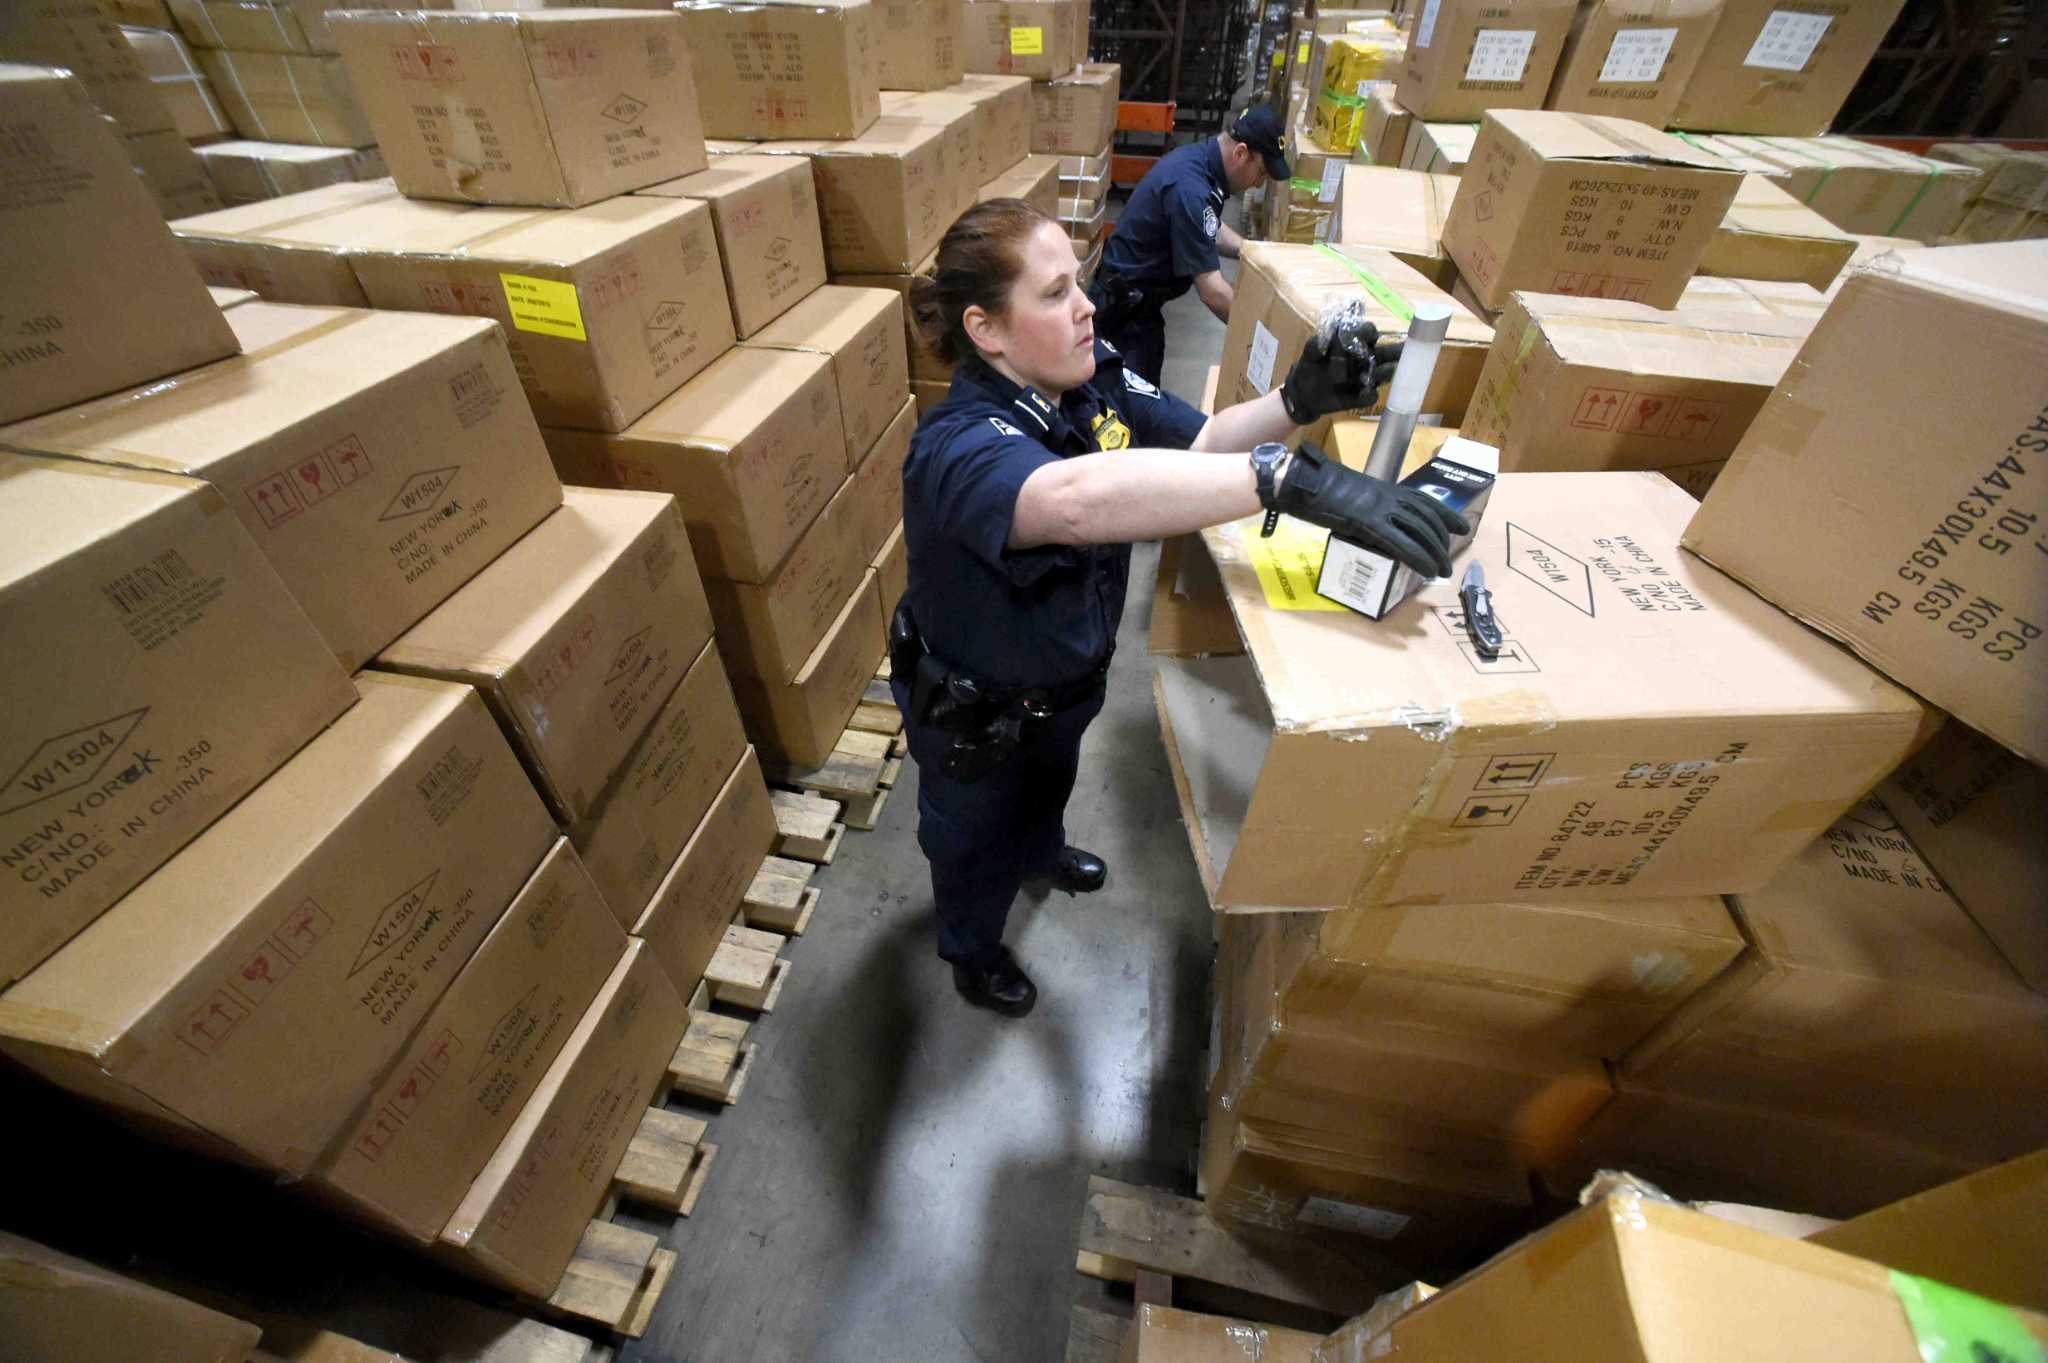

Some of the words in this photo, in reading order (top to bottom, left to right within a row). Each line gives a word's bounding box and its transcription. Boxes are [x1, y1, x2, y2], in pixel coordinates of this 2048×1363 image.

[1564, 212, 1592, 224] KGS
[1570, 197, 1599, 208] KGS
[1620, 200, 1634, 211] 10
[1561, 226, 1587, 238] PCS
[400, 476, 443, 510] W1504
[389, 529, 418, 557] NEW
[1978, 508, 2037, 556] 10.5
[405, 557, 438, 585] MADE
[455, 518, 488, 545] CHINA
[1526, 548, 1570, 583] W1504
[1614, 535, 1653, 566] CHINA
[1590, 555, 1628, 583] YORK
[1647, 565, 1669, 577] IN
[1619, 586, 1658, 612] NEW
[1661, 579, 1708, 611] MADE
[1861, 590, 1901, 625] CM
[1913, 578, 1966, 621] KGS
[1947, 596, 2004, 640] KGS
[1983, 616, 2043, 662] PCS
[22, 731, 115, 794] W1504
[1642, 762, 1677, 790] KGS
[1582, 821, 1605, 838] 48
[1615, 762, 1650, 789] PCS
[2, 819, 65, 869] NEW
[39, 841, 114, 898] MADE
[121, 816, 147, 838] IN
[150, 766, 214, 816] CHINA
[1843, 863, 1899, 885] MADE
[1901, 873, 1923, 889] IN
[372, 893, 421, 948] W1504
[360, 961, 395, 1006] NEW
[380, 980, 419, 1025] MADE
[422, 956, 438, 972] IN
[437, 907, 474, 953] CHINA
